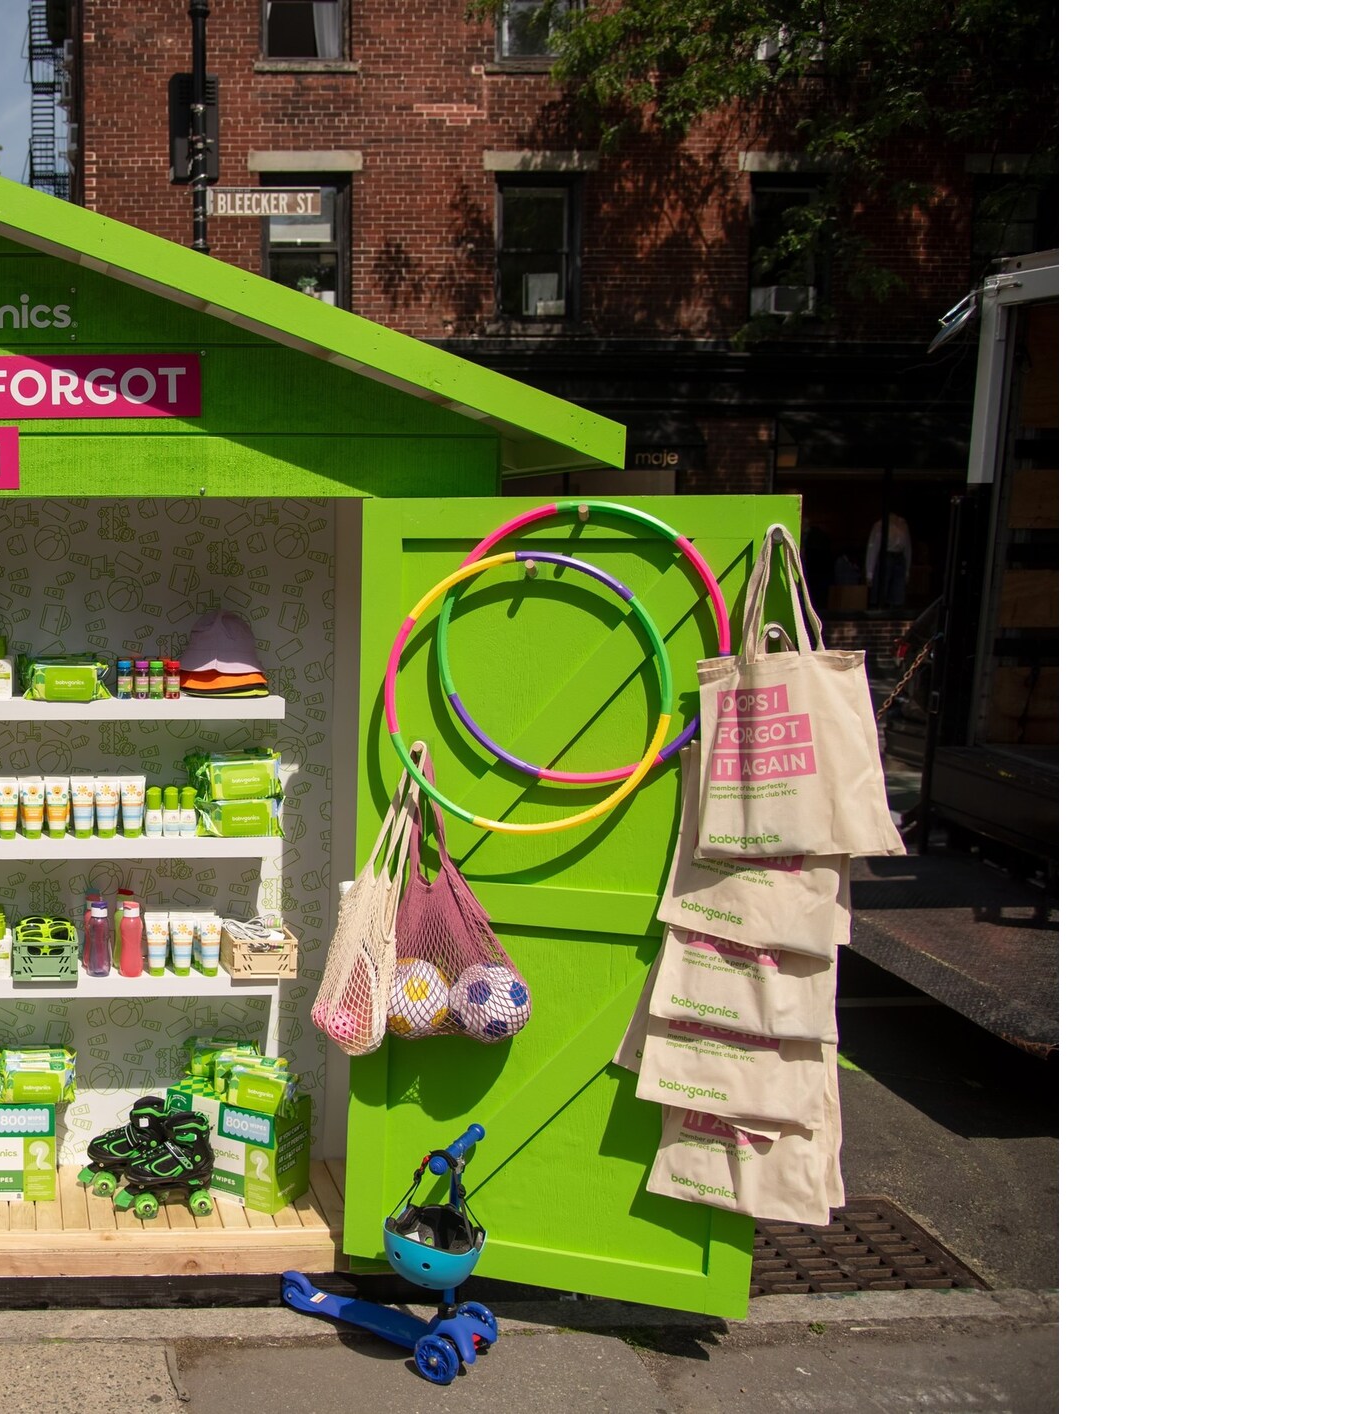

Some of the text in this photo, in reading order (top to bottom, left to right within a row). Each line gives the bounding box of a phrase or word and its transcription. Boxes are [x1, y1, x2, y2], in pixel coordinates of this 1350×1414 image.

[218, 192, 314, 214] BLEECKER ST
[635, 450, 679, 467] maje
[722, 692, 778, 713] OOPS I
[717, 721, 800, 744] FORGOT
[716, 752, 807, 776] IT AGAIN
[756, 782, 788, 792] perfectly
[764, 790, 780, 798] club
[690, 860, 775, 888] imperfect parent club NYC
[736, 866, 768, 878] perfectly
[684, 949, 708, 960] member
[682, 956, 766, 983] imperfect parent club NYC
[666, 1040, 755, 1063] imperfect parent club NYC
[667, 1033, 695, 1042] member
[716, 1042, 748, 1054] perfectly
[0, 1116, 26, 1126] 800
[226, 1116, 267, 1132] 800 WIPES
[688, 1110, 708, 1127] IT
[678, 1138, 710, 1151] imperfect
[710, 1147, 734, 1156] parent
[680, 1132, 706, 1142] member
[715, 1139, 727, 1147] the
[214, 1148, 240, 1161] ganics
[216, 1176, 236, 1186] WIPES
